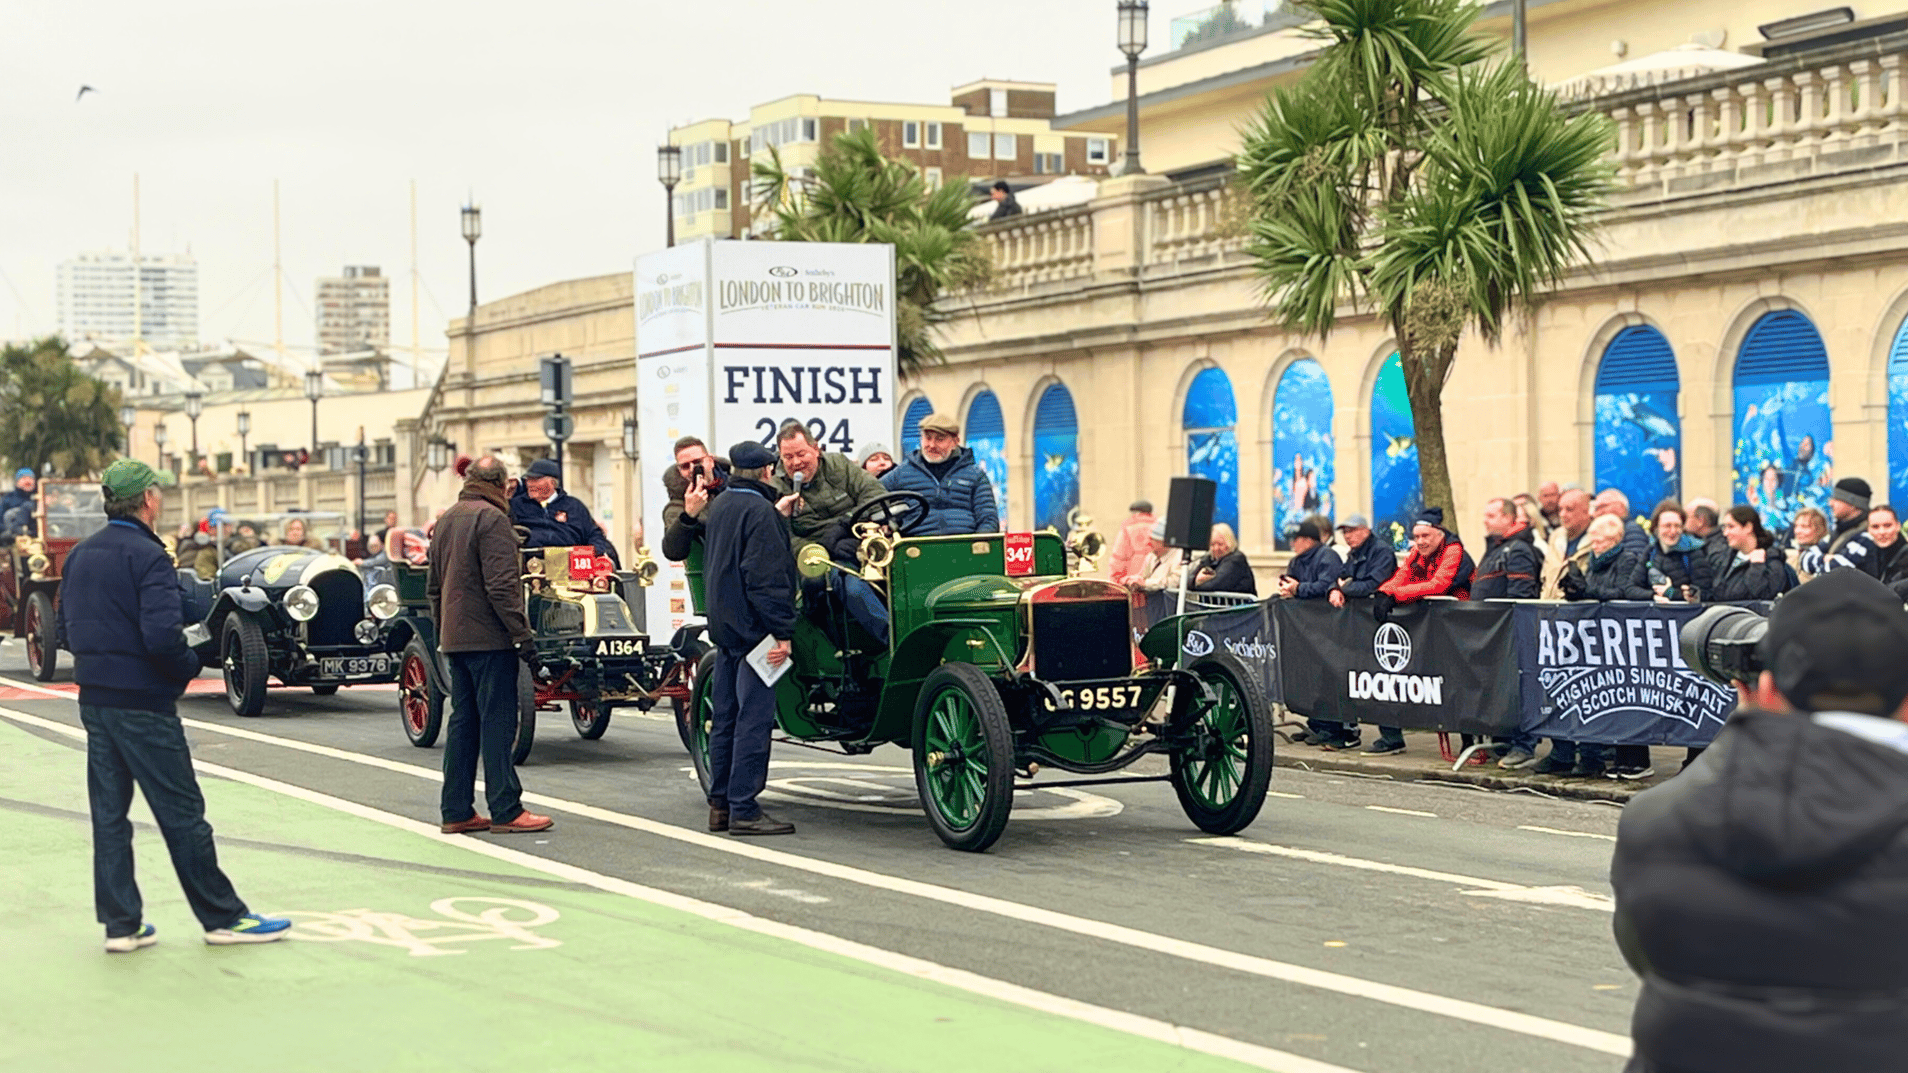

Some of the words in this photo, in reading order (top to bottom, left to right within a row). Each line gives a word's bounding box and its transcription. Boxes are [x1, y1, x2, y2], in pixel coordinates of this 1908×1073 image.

[719, 280, 782, 309] LONDON
[785, 281, 804, 302] TO
[809, 282, 884, 312] BRIGHTON
[724, 366, 882, 404] FINISH
[755, 417, 854, 453] 224
[574, 557, 592, 570] 181
[1007, 547, 1032, 562] 347
[1223, 636, 1277, 664] Sotheby's
[1538, 618, 1688, 667] ABERFEL
[324, 660, 345, 673] MK
[348, 659, 387, 672] 9376
[1080, 685, 1142, 710] 9557
[1348, 670, 1443, 705] LOCKTON
[1556, 668, 1626, 710] HIGHLAND
[1630, 667, 1683, 694] SINGLE
[1685, 682, 1727, 714] MALT
[1581, 687, 1636, 715] SCOTCH
[1640, 686, 1698, 718] WHISKY
